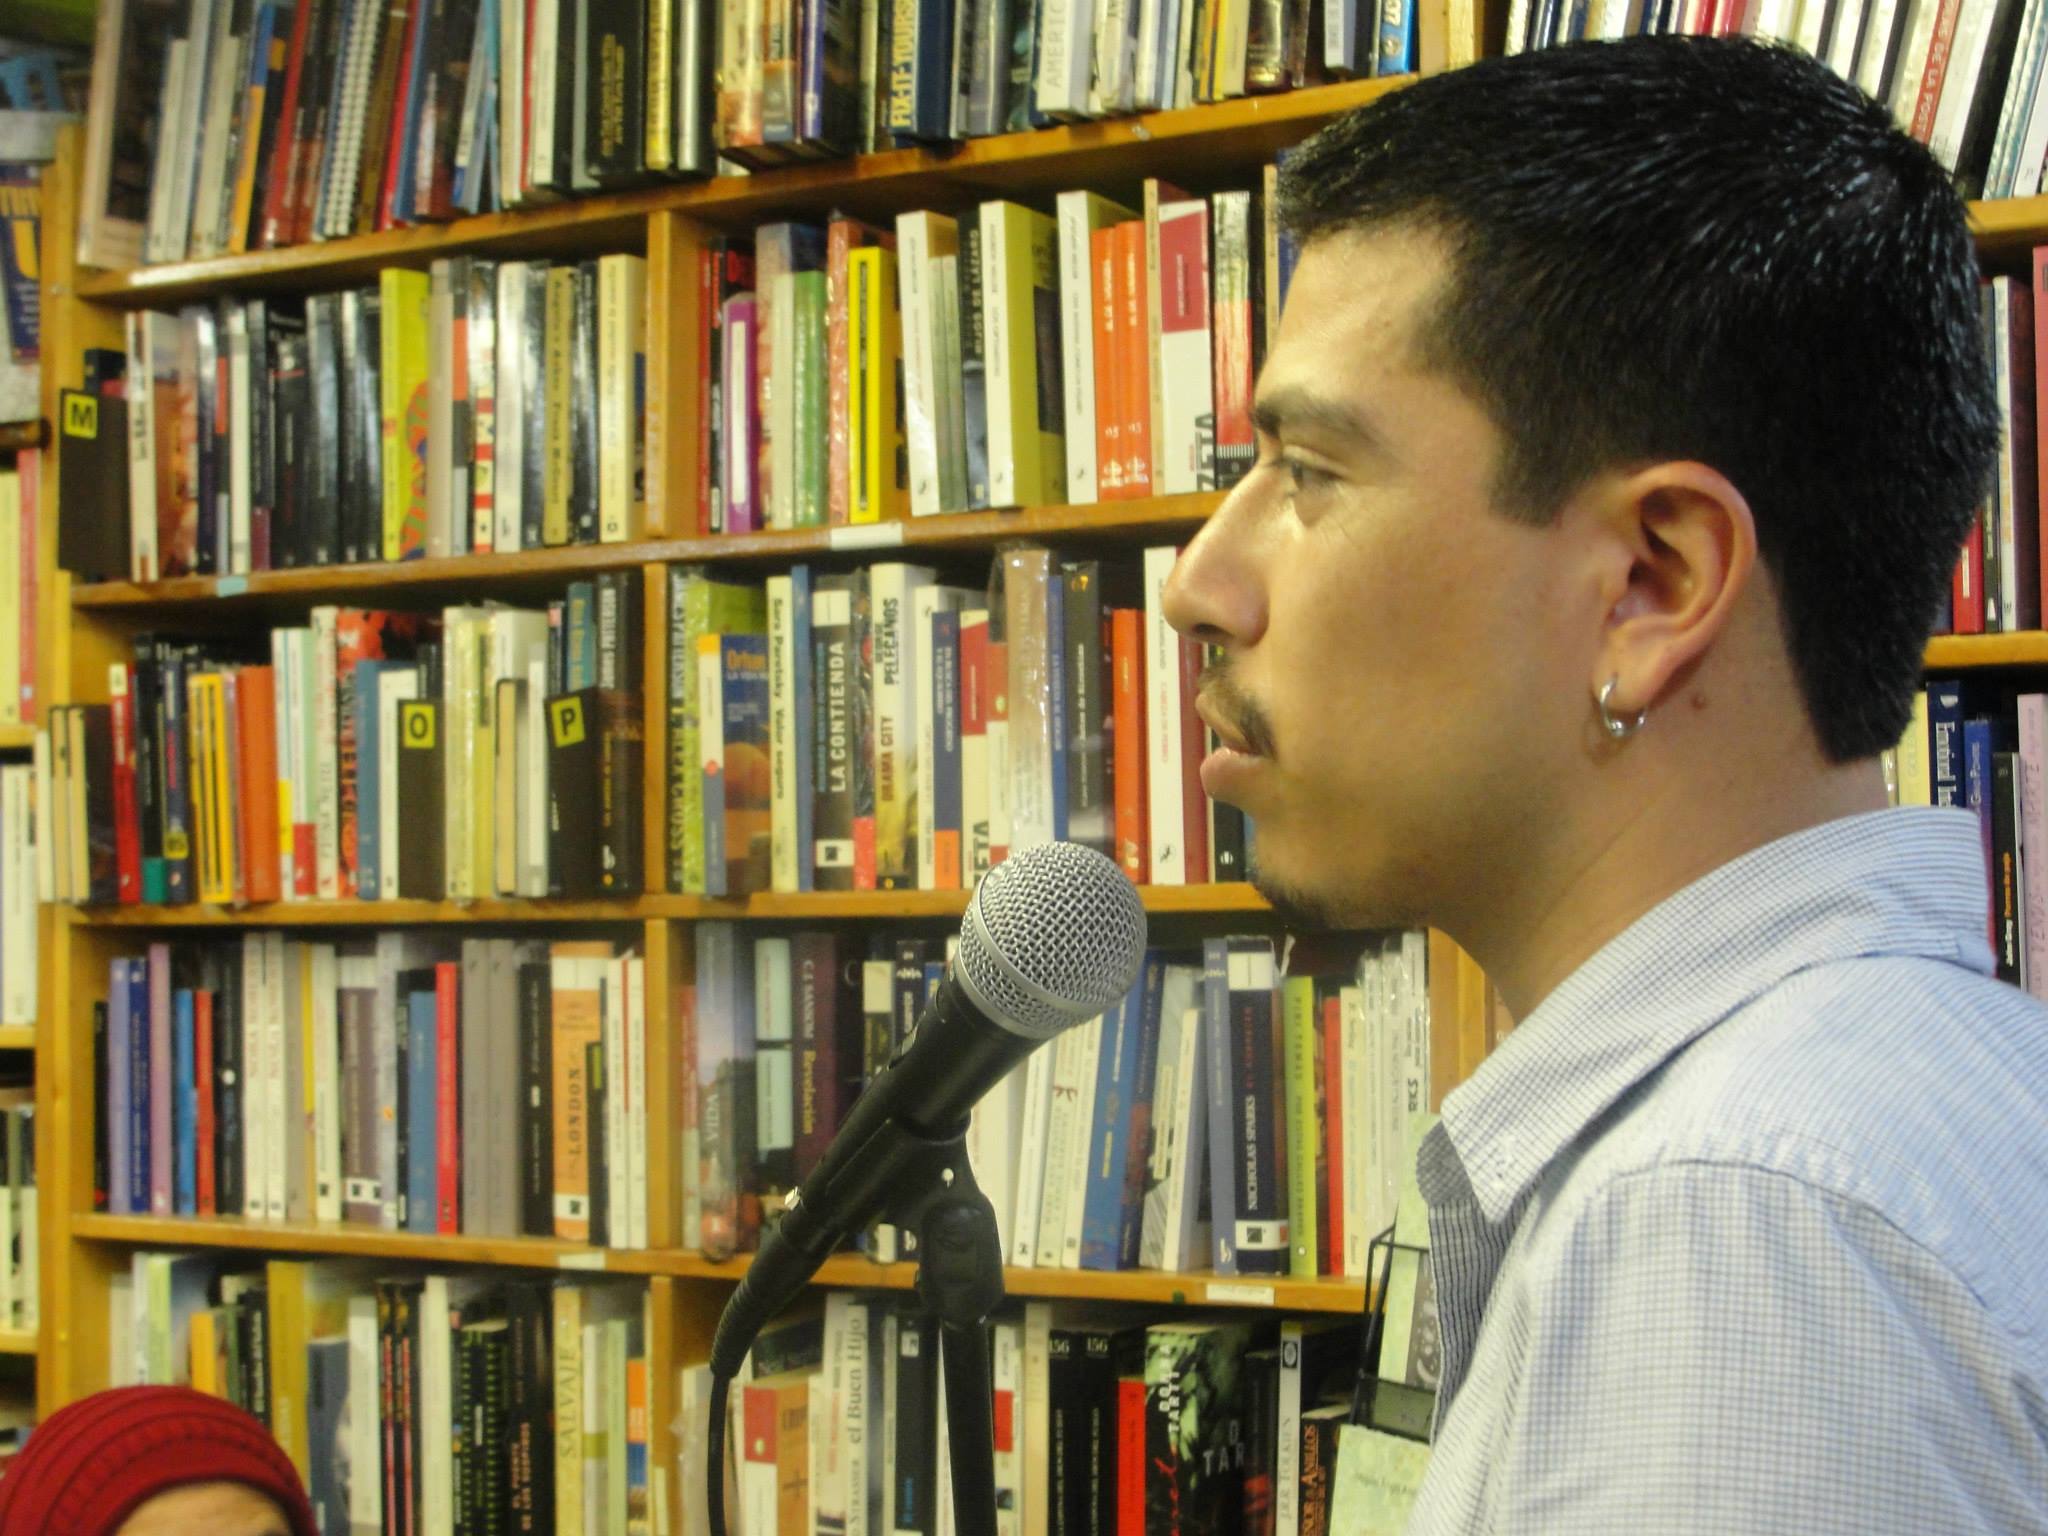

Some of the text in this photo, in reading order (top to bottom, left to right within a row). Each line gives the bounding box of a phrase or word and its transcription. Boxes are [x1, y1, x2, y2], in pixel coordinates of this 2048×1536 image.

[71, 404, 94, 430] M
[882, 598, 900, 685] PELECANOS
[409, 712, 429, 741] O
[560, 706, 577, 736] P
[829, 641, 847, 792] LA CONTIENDA
[879, 714, 895, 802] DRAMA CITY
[567, 1067, 582, 1156] LONDON
[1244, 1095, 1258, 1141] SPARKS
[1245, 1143, 1260, 1211] NICHOLAS
[846, 1318, 866, 1362] Hijo
[558, 1347, 579, 1460] SALVAJE
[846, 1369, 862, 1421] Buen
[1168, 1371, 1180, 1433] TARTT
